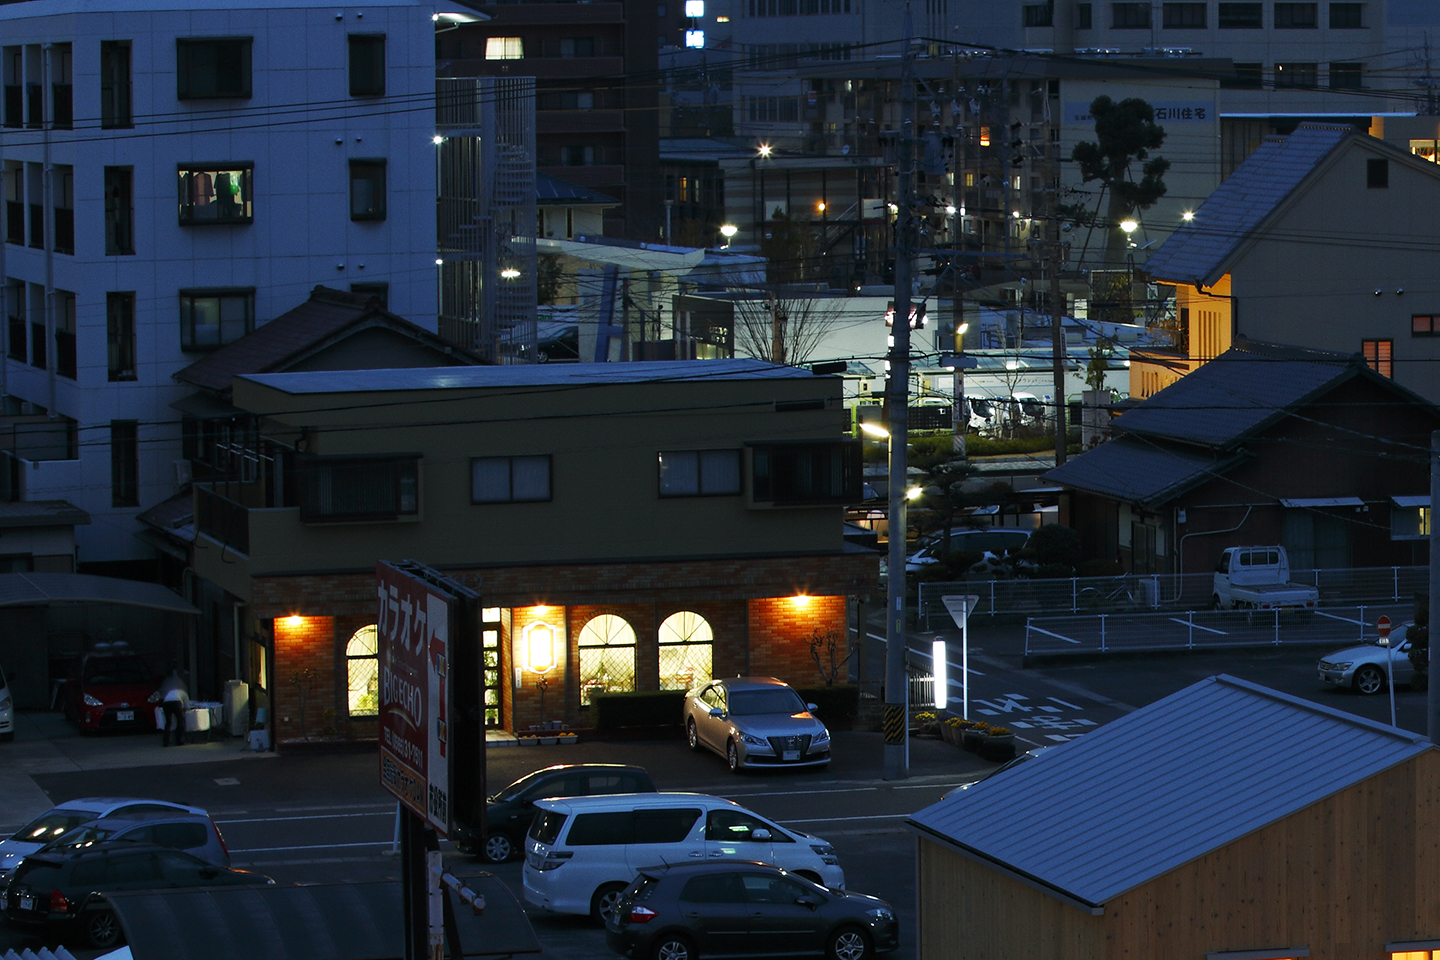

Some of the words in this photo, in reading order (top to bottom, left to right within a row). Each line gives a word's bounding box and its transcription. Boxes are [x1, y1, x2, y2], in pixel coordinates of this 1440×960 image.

[1155, 107, 1206, 120] 石川住宅
[378, 579, 427, 656] カラオケ
